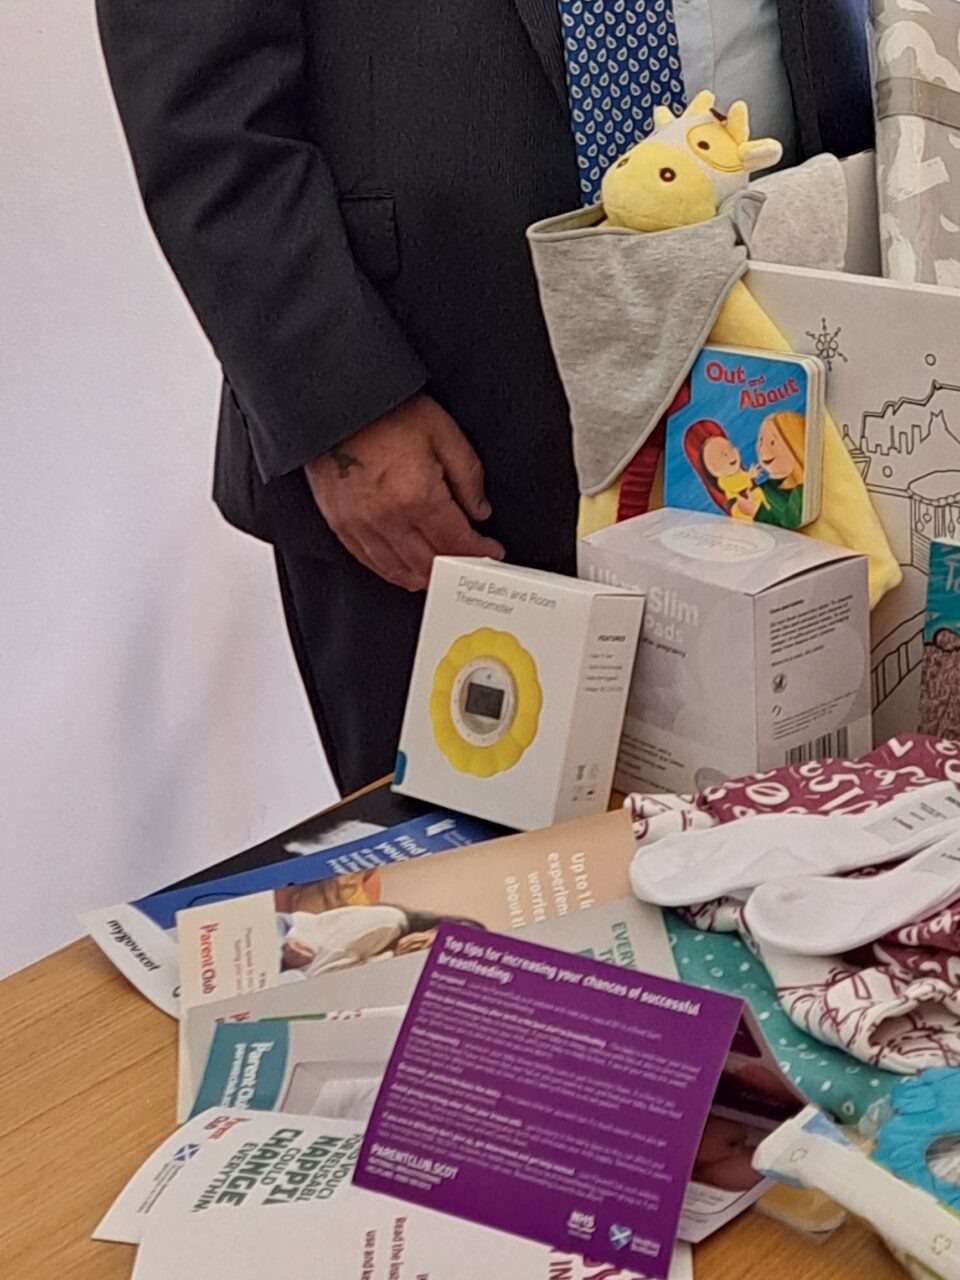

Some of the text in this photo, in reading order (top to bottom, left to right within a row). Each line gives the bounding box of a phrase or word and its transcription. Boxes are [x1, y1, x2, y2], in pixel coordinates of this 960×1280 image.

[704, 362, 746, 385] Out
[748, 375, 766, 388] and
[738, 376, 799, 411] About
[456, 591, 514, 615] Thermometer
[457, 575, 557, 609] Digital Bath and Room
[649, 586, 699, 626] Slim
[570, 852, 586, 872] Up
[504, 875, 523, 917] about
[575, 873, 589, 891] to
[200, 922, 219, 995] Parent Club
[444, 936, 702, 1018] Top tips for increasing your chances of successful
[240, 1041, 275, 1087] Parent
[189, 1142, 257, 1213] EVERYTHIN
[216, 1128, 304, 1207] CHANGE
[261, 1147, 301, 1186] COULD
[365, 1230, 376, 1248] use
[394, 1216, 407, 1246] Read
[362, 1250, 375, 1269] and
[390, 1244, 404, 1261] the
